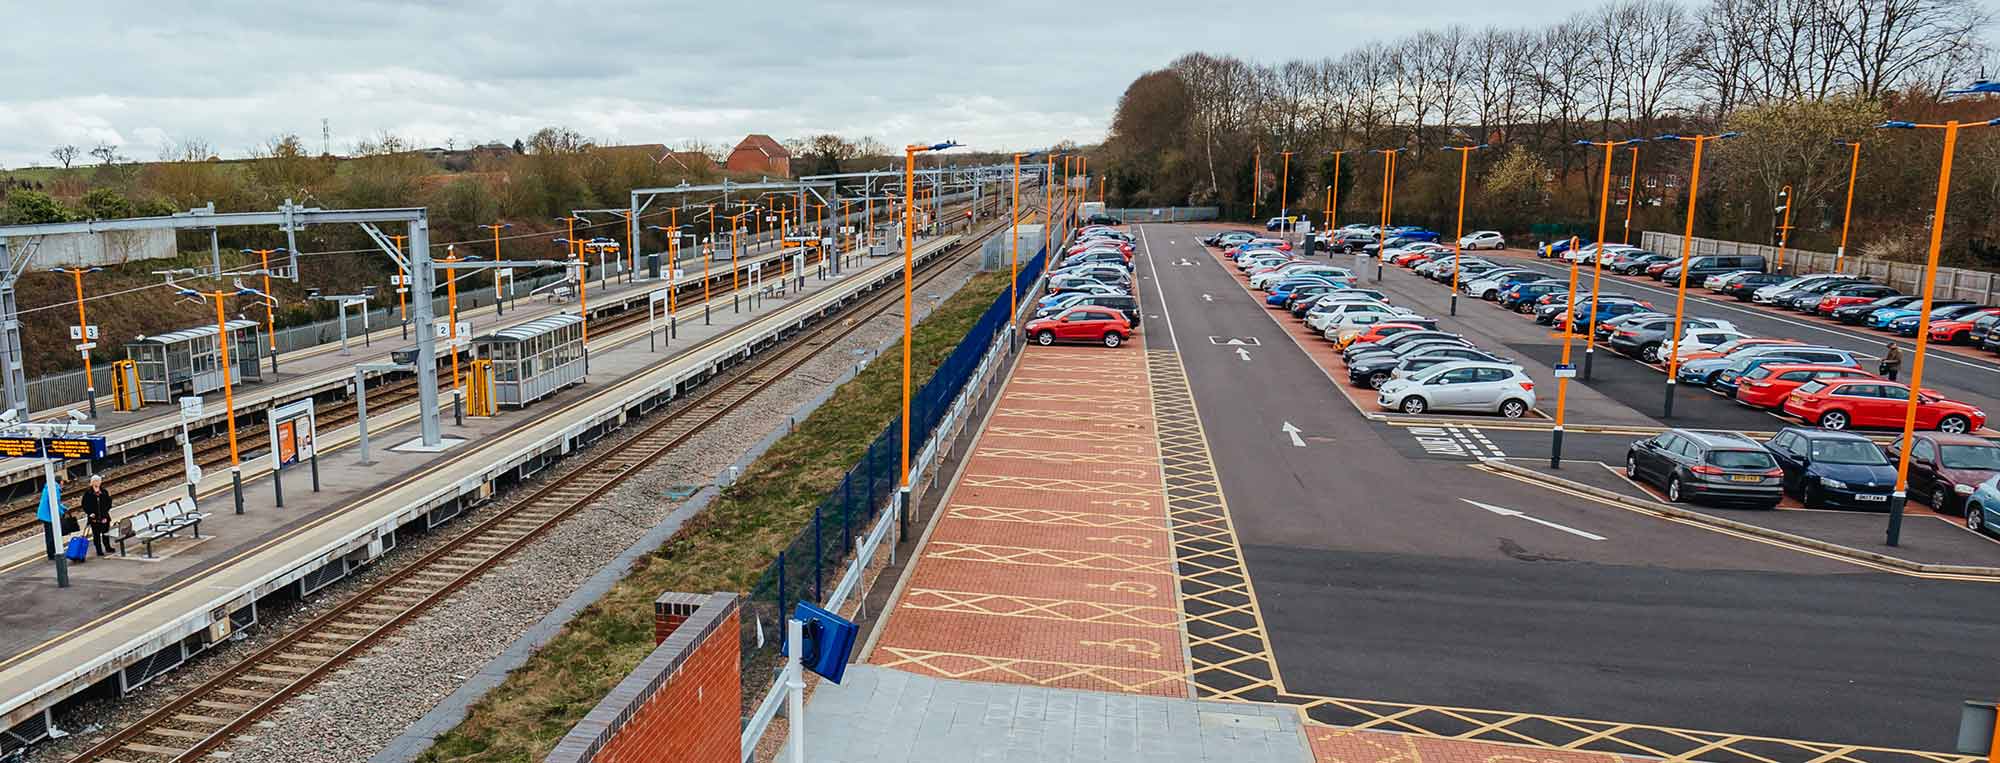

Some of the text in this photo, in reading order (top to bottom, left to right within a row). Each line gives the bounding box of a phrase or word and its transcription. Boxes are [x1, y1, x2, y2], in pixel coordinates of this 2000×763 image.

[73, 327, 94, 337] 4 3
[440, 326, 446, 334] 2
